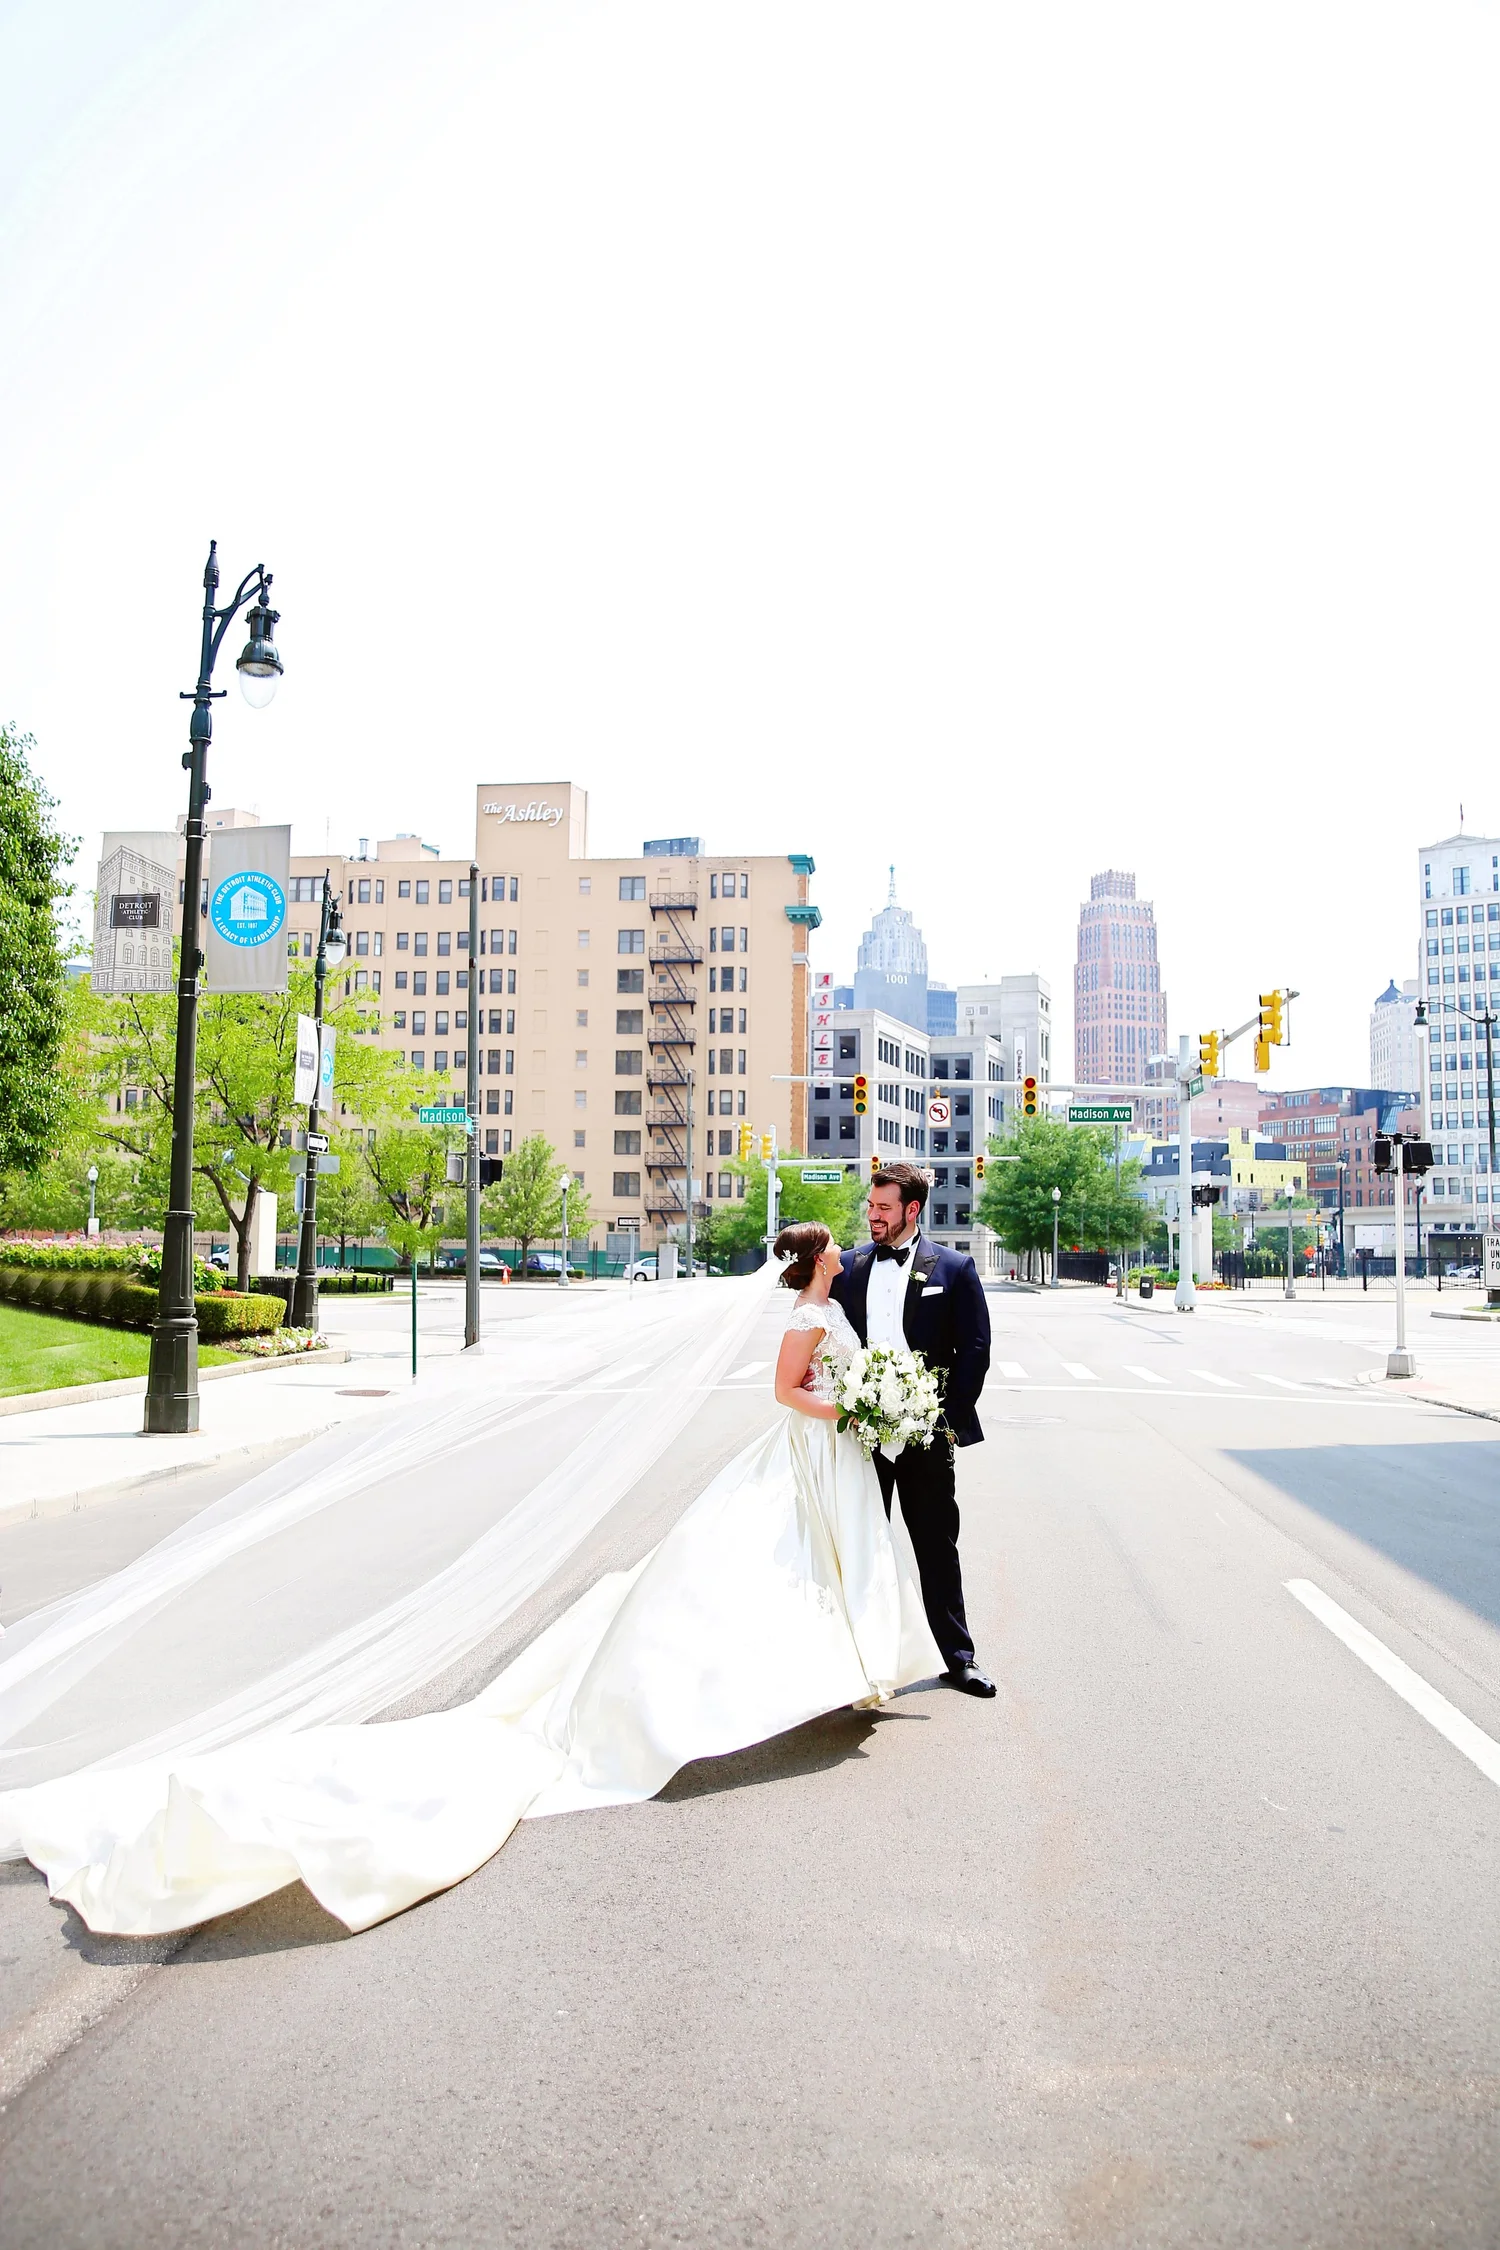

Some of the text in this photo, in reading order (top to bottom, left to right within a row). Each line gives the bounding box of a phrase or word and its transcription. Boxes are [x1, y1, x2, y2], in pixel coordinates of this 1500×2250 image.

[482, 801, 564, 827] The Ashley
[215, 875, 282, 904] THE DETROIT ATHLETIC CLUB
[119, 902, 152, 910] DETROIT
[218, 922, 238, 942] LEGACY
[250, 916, 281, 944] LEADERSHIP
[885, 974, 908, 984] 1001
[422, 1110, 464, 1122] Madison
[1070, 1109, 1130, 1118] Madison Ave
